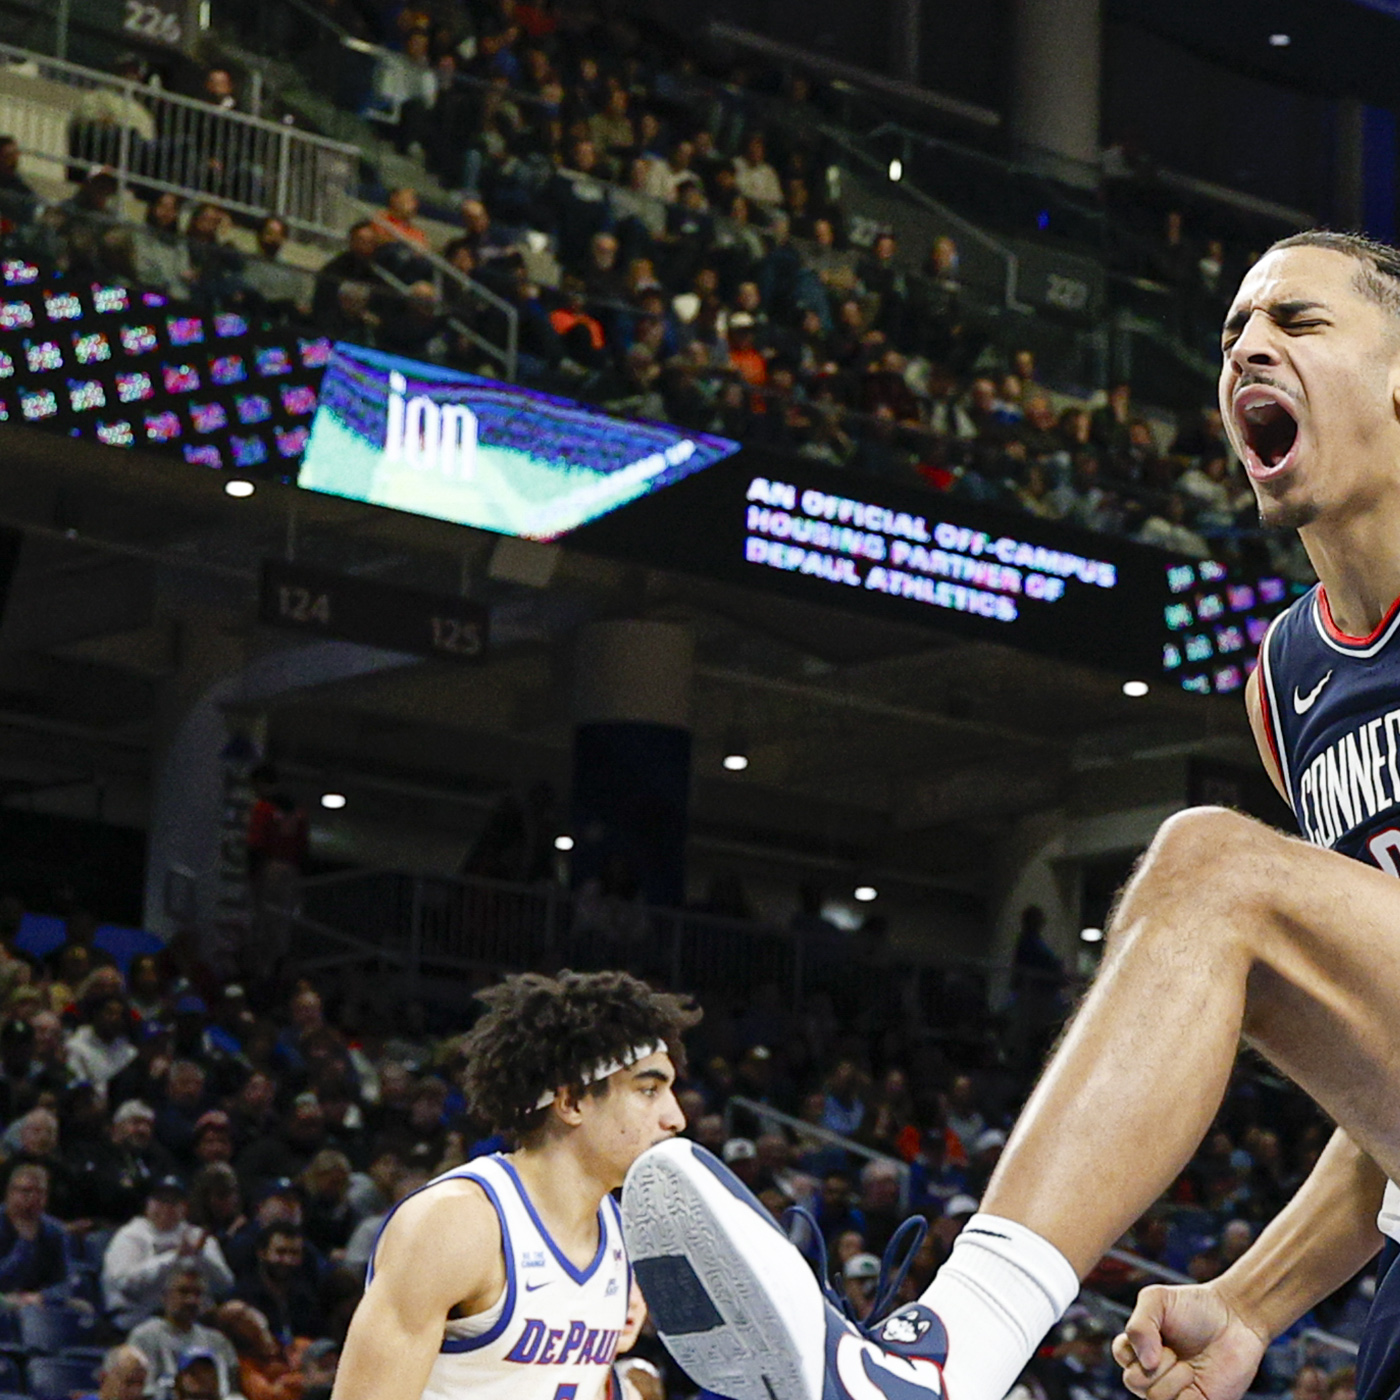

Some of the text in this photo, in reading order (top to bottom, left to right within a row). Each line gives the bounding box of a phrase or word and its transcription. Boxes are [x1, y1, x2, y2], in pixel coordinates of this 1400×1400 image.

[746, 477, 1117, 588] AN OFFICIAL OFF-CAMPUS
[746, 504, 1066, 603] HOUSING PARTNER OF
[864, 565, 1019, 622] ATHLETICS
[502, 1318, 621, 1365] DEPAU
